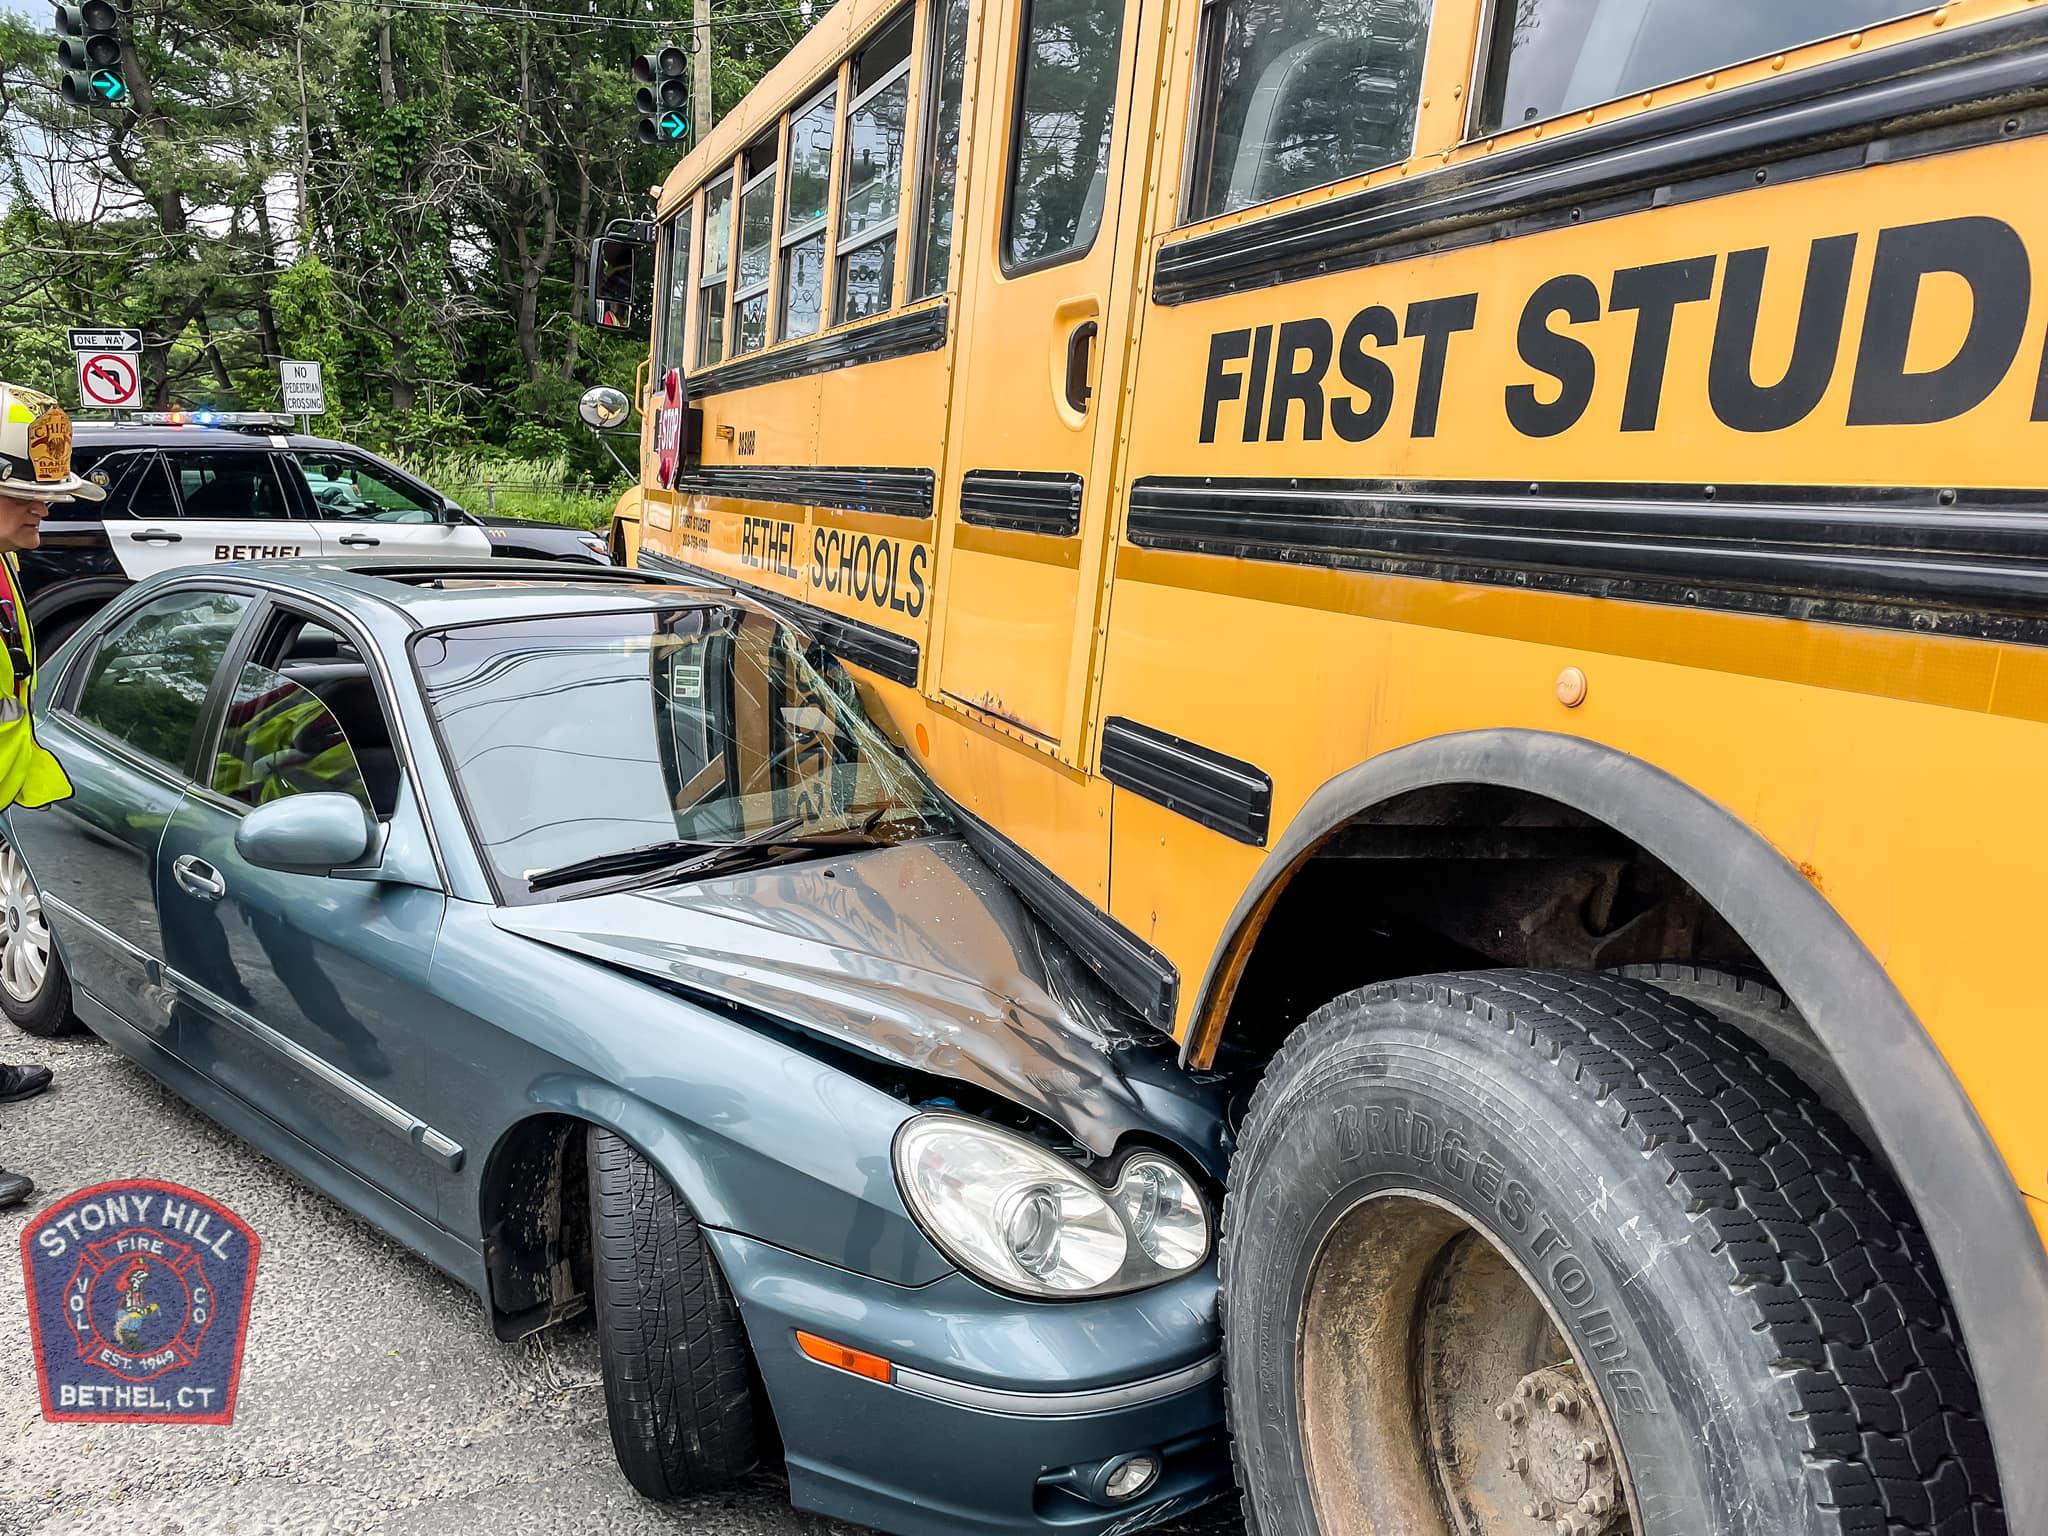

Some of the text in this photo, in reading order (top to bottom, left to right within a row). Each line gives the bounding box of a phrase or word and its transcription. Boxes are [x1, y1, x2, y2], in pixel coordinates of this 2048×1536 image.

[76, 335, 126, 345] ONE WAY
[1199, 215, 2048, 444] FIRST STUD
[294, 366, 307, 378] NO
[285, 382, 320, 394] PEDESTRIAN
[288, 398, 322, 409] CROSSING
[661, 408, 679, 450] STOP
[741, 516, 927, 618] BETHEL SCHOOLS
[1332, 1104, 1660, 1416] BRIDGESTONE
